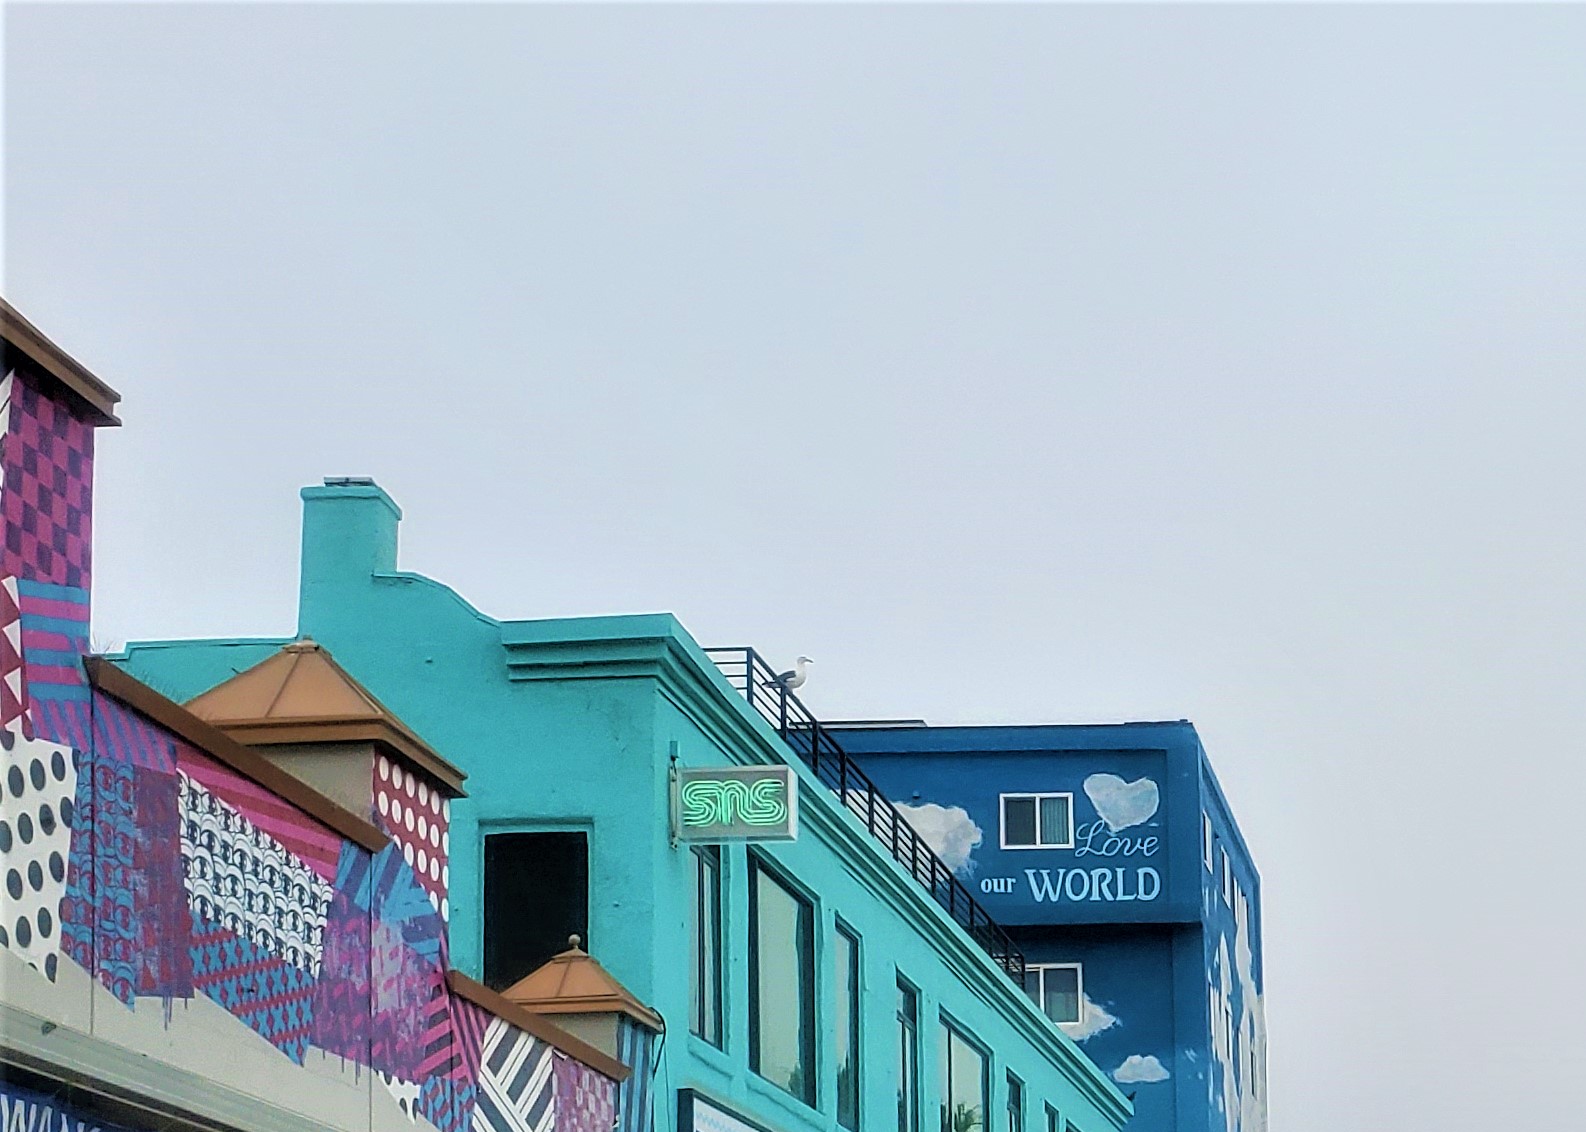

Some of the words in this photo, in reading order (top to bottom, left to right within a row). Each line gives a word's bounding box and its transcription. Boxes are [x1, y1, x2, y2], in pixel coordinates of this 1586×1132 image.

[1075, 820, 1159, 859] Love
[980, 876, 1017, 896] our
[1024, 867, 1161, 903] WORLD
